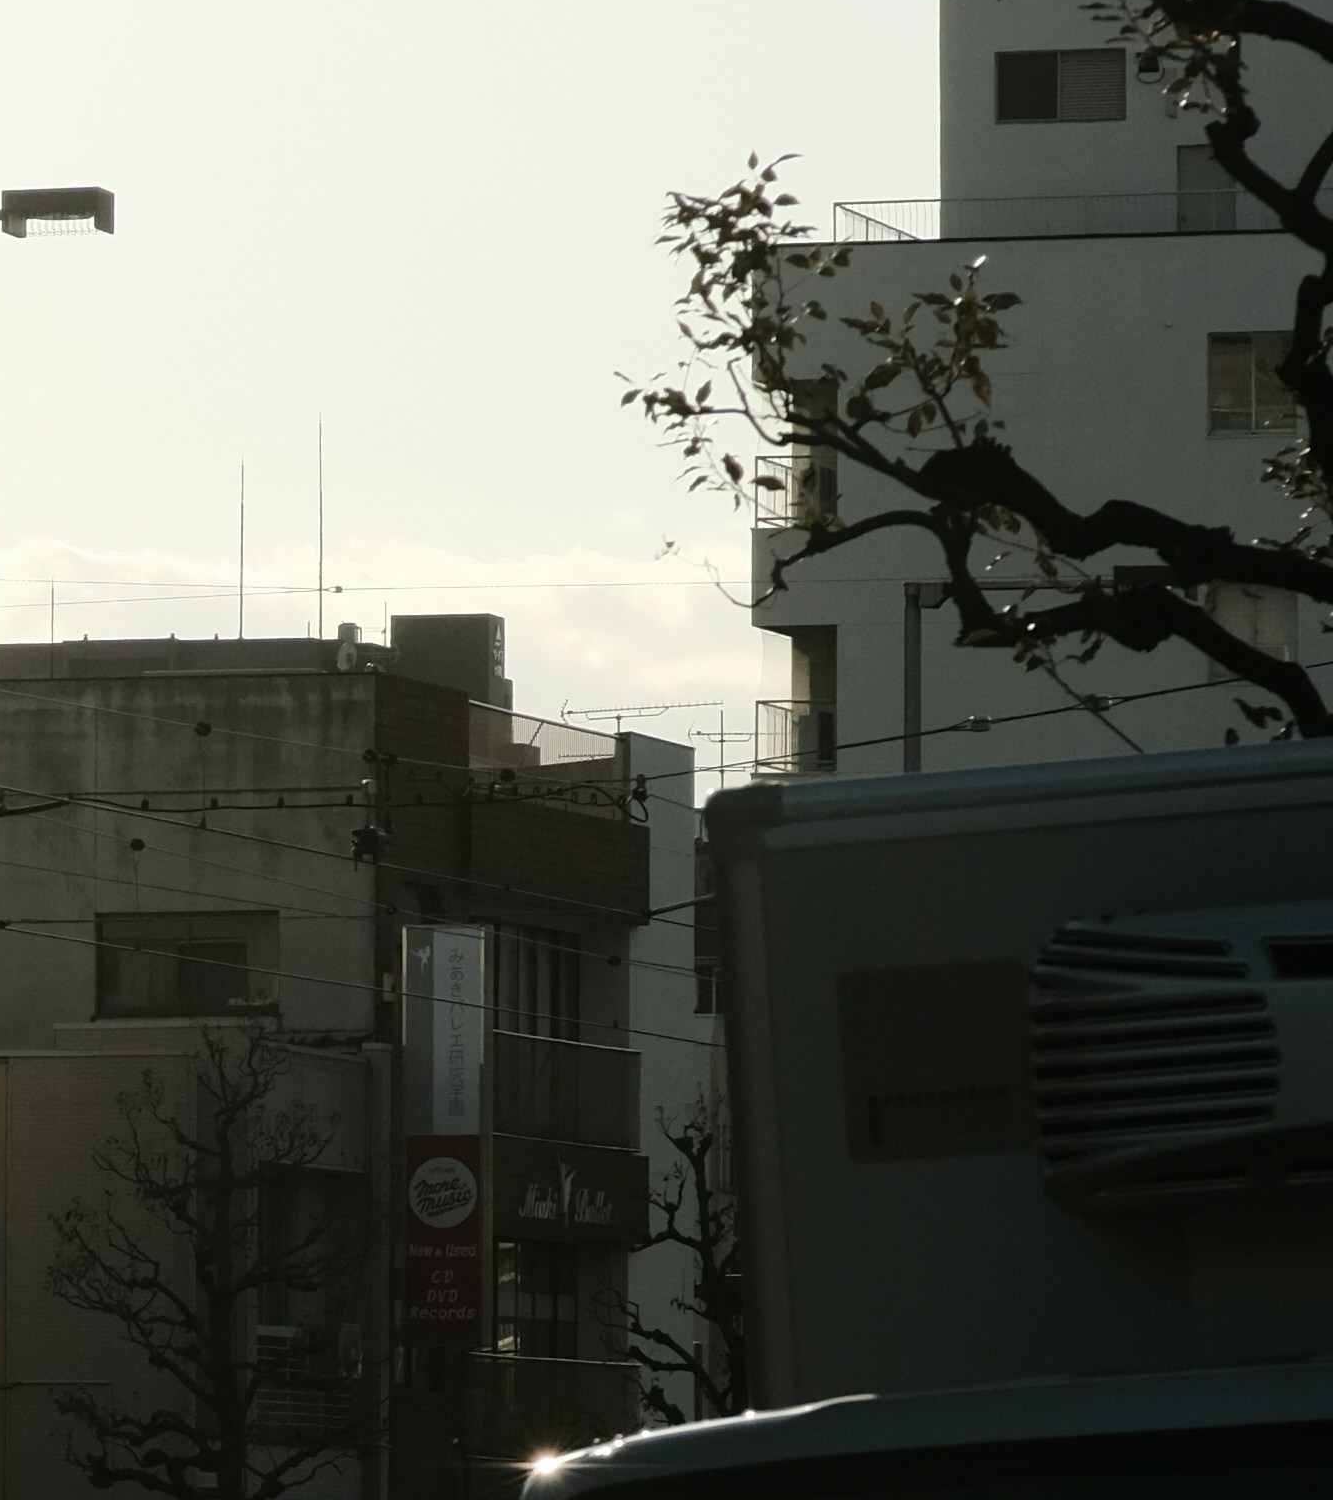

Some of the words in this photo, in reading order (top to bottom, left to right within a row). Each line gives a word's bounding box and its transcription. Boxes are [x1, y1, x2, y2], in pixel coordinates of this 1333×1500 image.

[409, 1244, 432, 1258] New
[445, 1244, 477, 1258] Used
[431, 1270, 454, 1284] CD
[426, 1289, 459, 1303] DVD
[409, 1306, 477, 1320] Records
